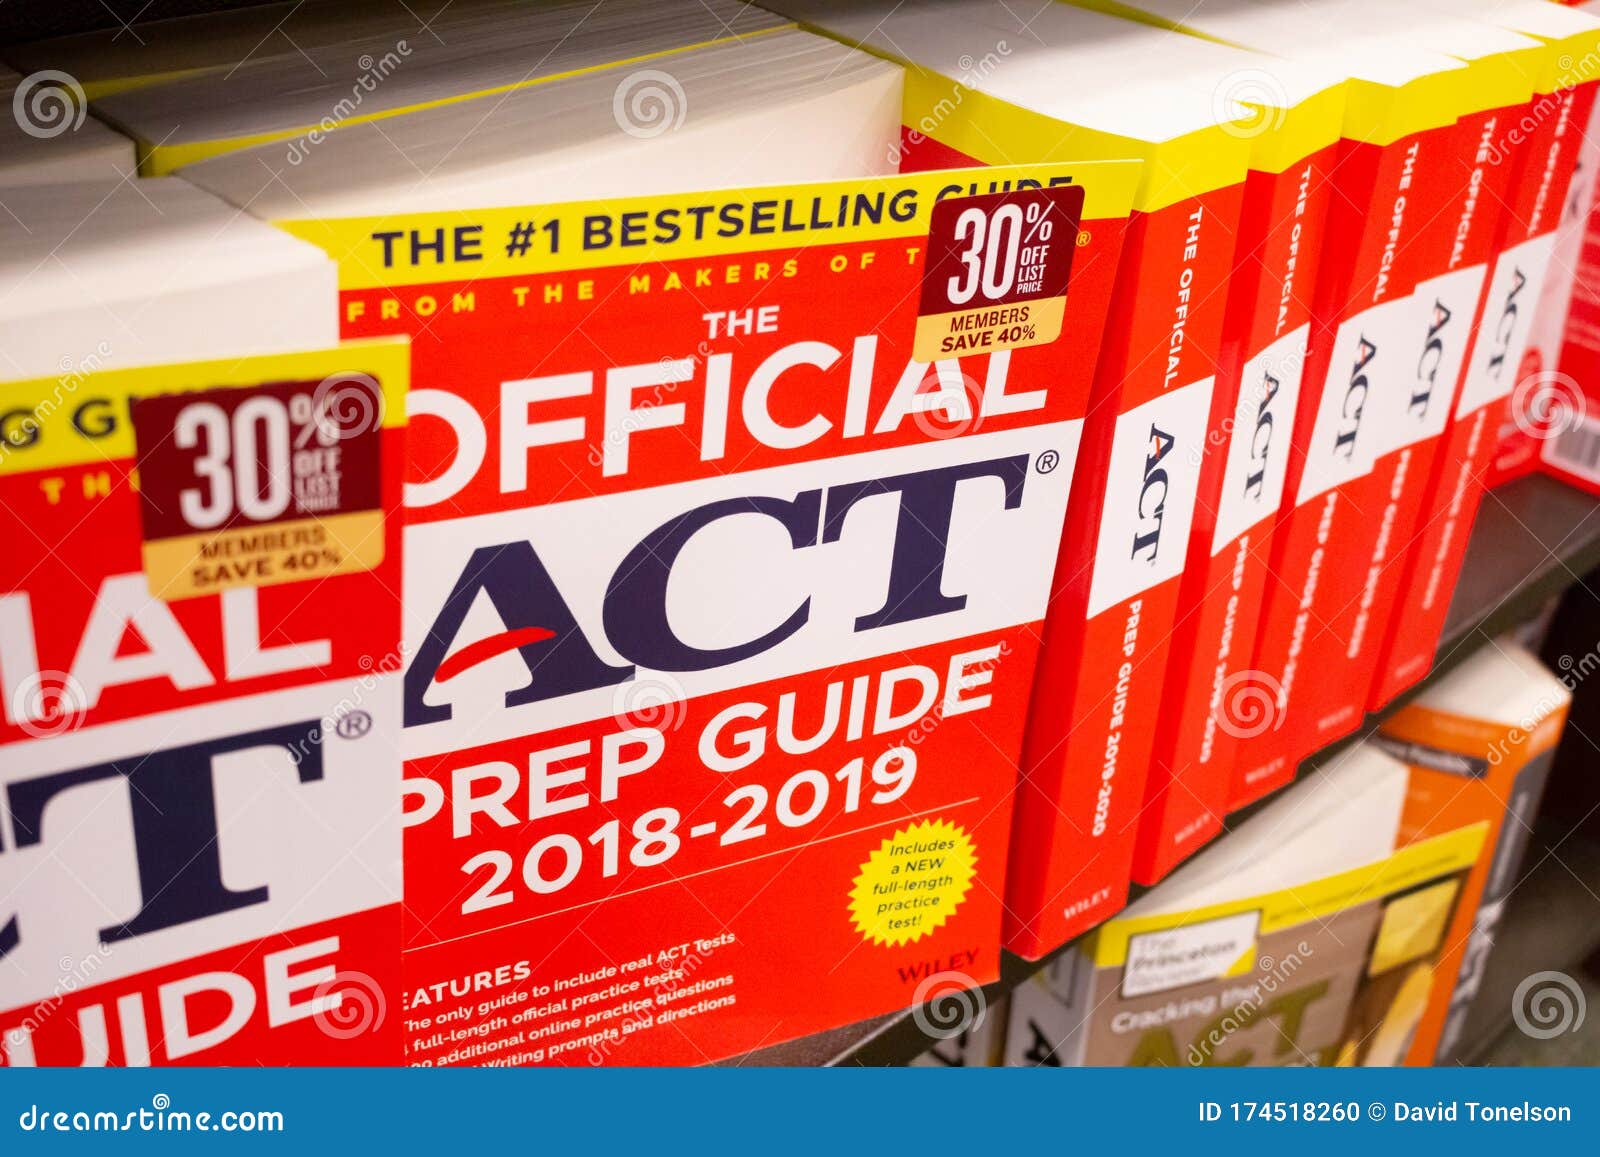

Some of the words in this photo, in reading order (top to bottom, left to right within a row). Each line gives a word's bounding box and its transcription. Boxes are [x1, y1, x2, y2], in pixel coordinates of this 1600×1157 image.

[1295, 165, 1311, 216] THE
[1399, 142, 1419, 190] THE
[372, 225, 483, 267] THE
[506, 219, 561, 257] #1
[583, 189, 918, 251] BESTSELLING
[947, 200, 1056, 305] 30%
[1020, 245, 1050, 266] OFF
[1183, 206, 1203, 262] THE
[1374, 196, 1406, 303] OFFICIAL
[347, 292, 476, 323] FROM
[513, 280, 595, 307] THE
[629, 259, 798, 295] MAKERS
[830, 251, 876, 273] OF
[1016, 281, 1043, 294] PRICE
[1018, 264, 1047, 283] LIST
[1275, 222, 1302, 336] OFFICIAL
[702, 305, 781, 340] THE
[941, 330, 993, 353] SAVE
[997, 323, 1036, 344] 40%
[950, 306, 1030, 333] MEMBERS
[1164, 268, 1193, 388] OFFICIAL
[404, 334, 1048, 508] OFFICIAL
[1333, 333, 1377, 462] ACT
[1243, 370, 1280, 503] ACT
[1131, 423, 1175, 562] ACT
[200, 526, 326, 559] MEMBERS
[192, 557, 270, 588] SAVE
[1123, 600, 1143, 657] PREP
[699, 645, 1000, 774] GUIDE
[1109, 662, 1132, 730] GUIDE
[1092, 732, 1121, 837] 2019-2020
[461, 745, 918, 914] 2018-2019
[890, 839, 955, 856] Includes
[873, 875, 953, 895] full-length
[891, 865, 900, 875] a
[905, 857, 945, 873] NEW
[877, 896, 940, 916] practice
[888, 915, 923, 930] test!
[1064, 887, 1112, 920] WILEY
[404, 1017, 431, 1032] he
[436, 1006, 474, 1025] only
[478, 991, 528, 1015] guide
[532, 985, 550, 997] to
[554, 966, 617, 991] include
[620, 954, 653, 973] real
[656, 943, 690, 964] ACT
[694, 933, 736, 952] Tests
[897, 948, 979, 984] WILEY
[413, 1017, 508, 1052] full-length
[511, 999, 568, 1024] official
[572, 980, 640, 1011] practice
[644, 967, 684, 988] tests
[437, 1031, 525, 1067] additional
[528, 1017, 582, 1041] online
[585, 997, 653, 1028] practice
[656, 975, 734, 1006] questions
[548, 1027, 618, 1060] prompts
[622, 1016, 653, 1035] and
[657, 994, 736, 1025] directions
[1111, 995, 1217, 1034] Cracking
